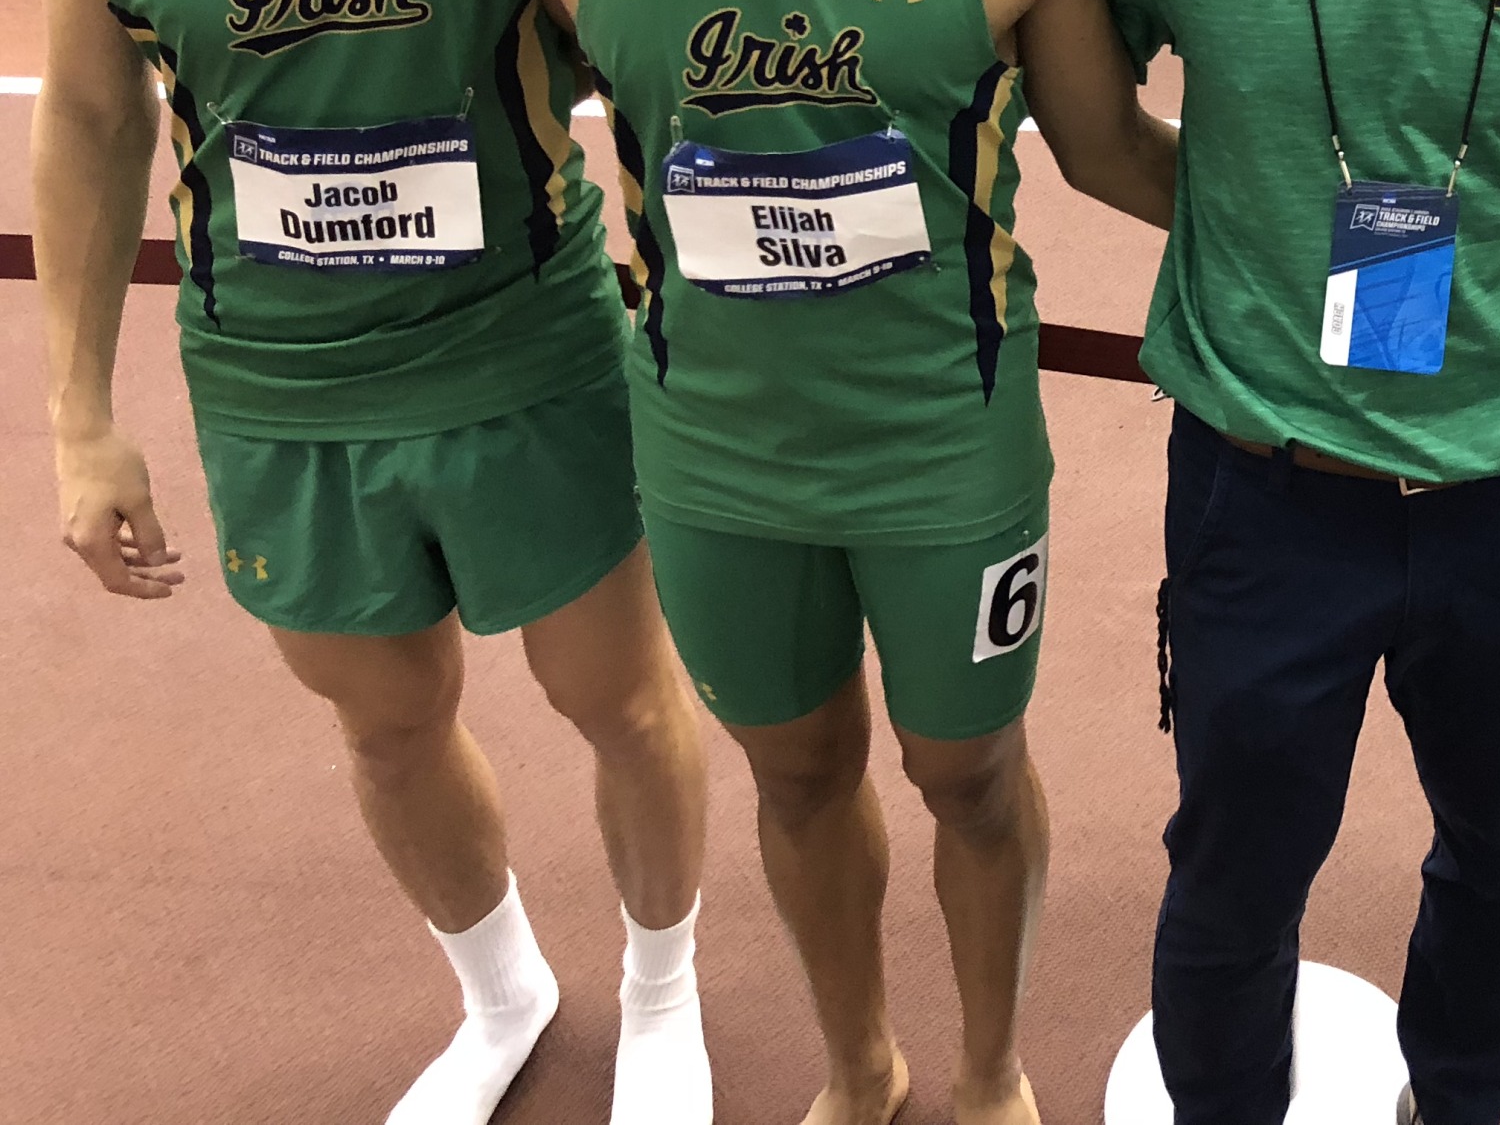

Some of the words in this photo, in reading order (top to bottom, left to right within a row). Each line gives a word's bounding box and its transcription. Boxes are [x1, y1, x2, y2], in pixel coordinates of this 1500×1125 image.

[680, 6, 881, 119] Irish
[259, 148, 299, 166] TRACK
[301, 153, 311, 166] &
[313, 153, 351, 166] FIELD
[354, 139, 469, 166] CHAMPIONSHIPS
[696, 176, 739, 188] TRACK
[740, 177, 751, 188] &
[752, 177, 789, 190] FIELD
[791, 160, 906, 191] CHAMPIONSHIPS
[304, 180, 398, 208] Jacob
[280, 206, 436, 244] Dumford
[751, 205, 835, 234] Elijah
[1378, 211, 1407, 223] TRACK
[1407, 213, 1415, 224] &
[1415, 215, 1440, 226] FIELD
[278, 250, 315, 265] COLLEGE
[316, 255, 359, 267] STATION,
[362, 254, 374, 265] TX
[390, 254, 423, 265] MARCH
[425, 255, 446, 265] 9-10
[756, 236, 847, 268] Silva
[811, 280, 822, 291] TX
[988, 553, 1039, 647] 6
